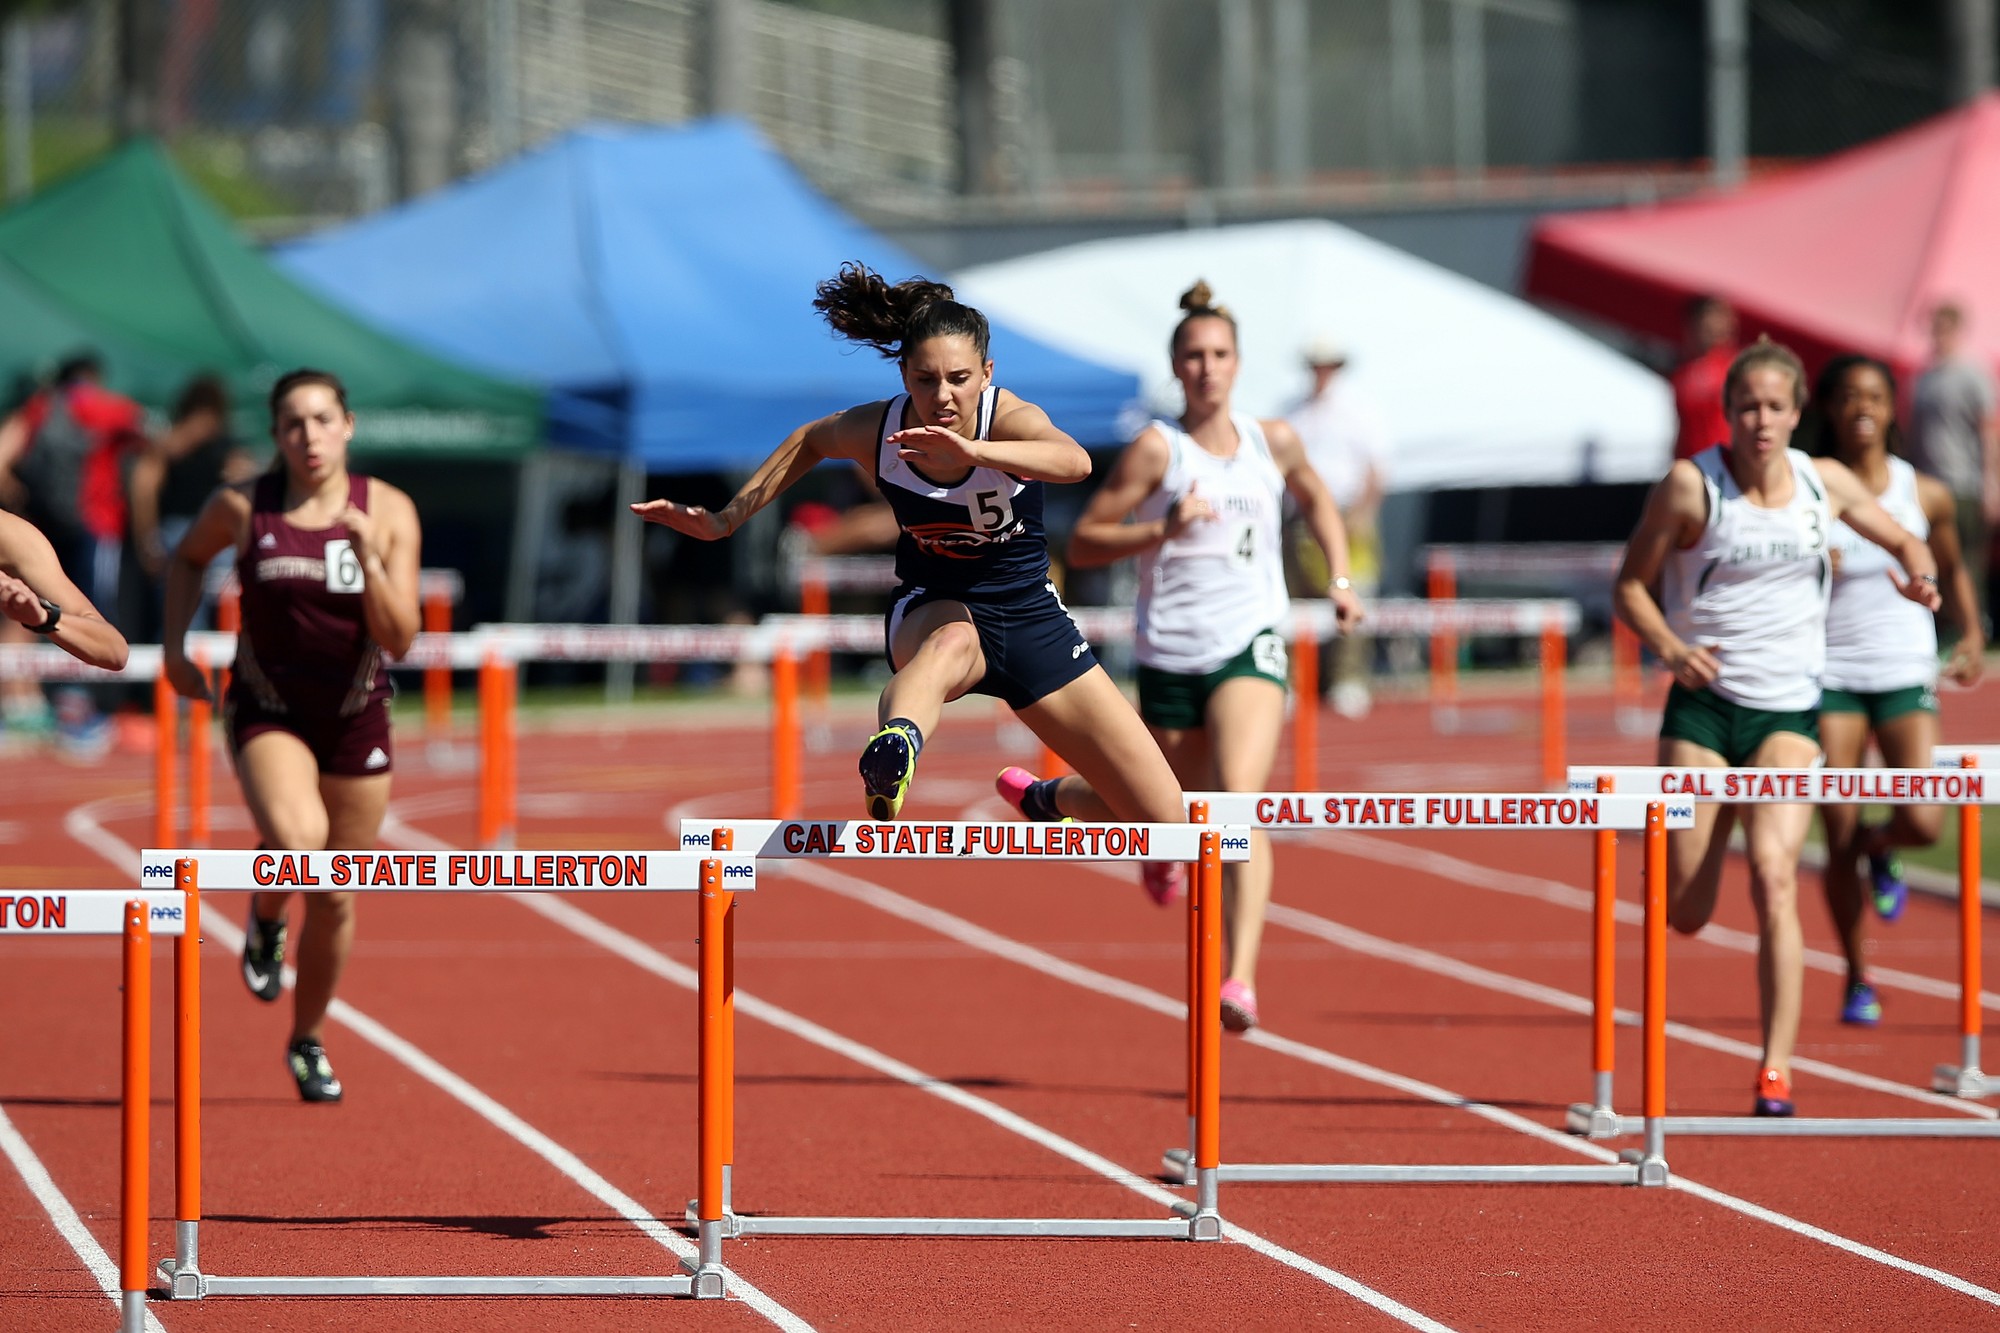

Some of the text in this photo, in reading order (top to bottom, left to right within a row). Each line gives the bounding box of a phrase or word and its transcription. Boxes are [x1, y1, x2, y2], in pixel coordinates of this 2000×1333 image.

[975, 490, 1005, 530] 5
[1237, 526, 1253, 563] 4
[1803, 509, 1824, 549] 3
[338, 546, 358, 586] 6
[1660, 772, 1984, 798] CAL STATE FULLERTON
[1255, 797, 1599, 825] CAL STATE FULLERTON
[783, 823, 1150, 856] CAL STATE FULLERTON
[252, 854, 648, 887] CAL STATE FULLERTON
